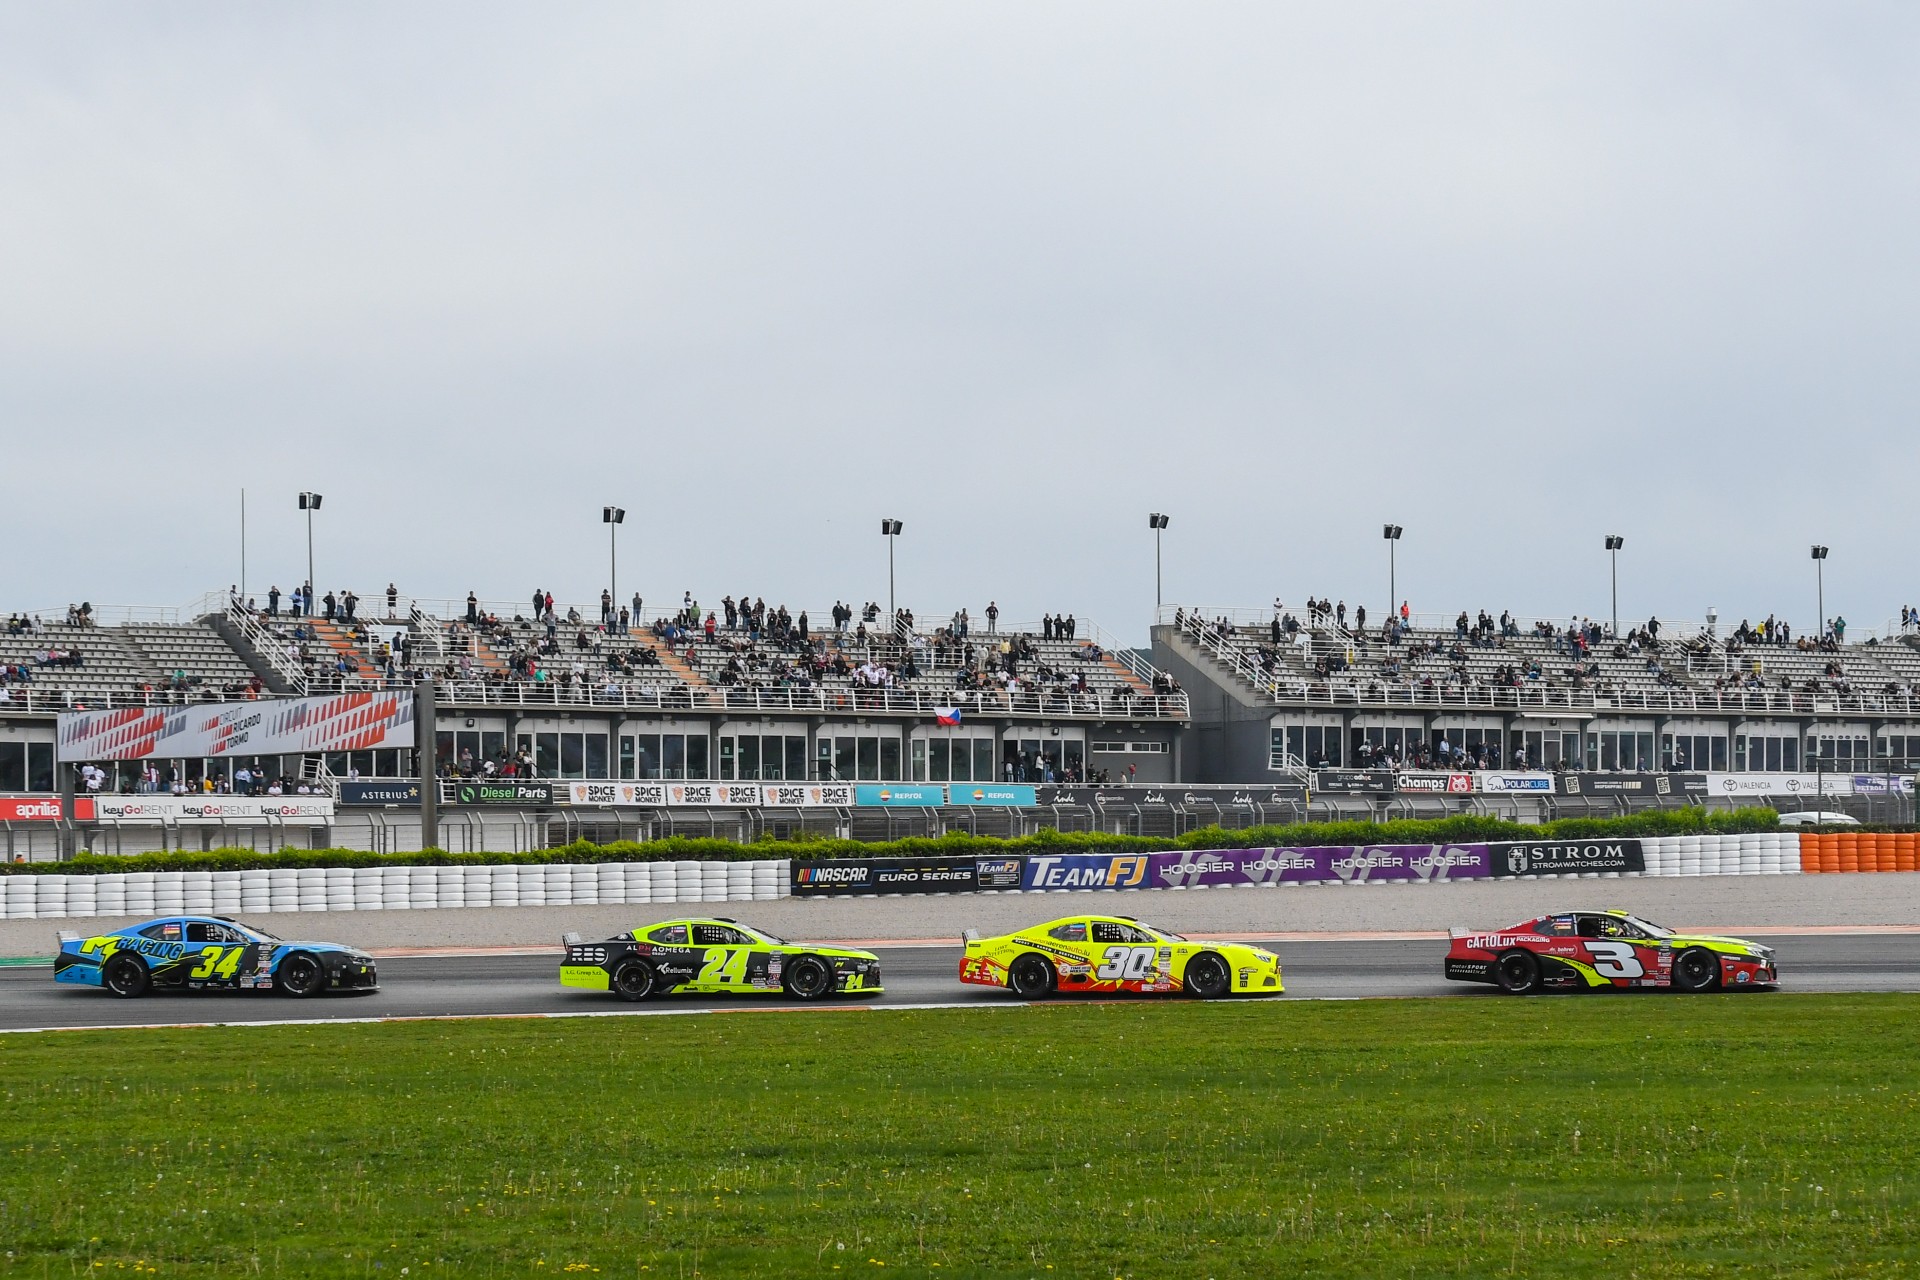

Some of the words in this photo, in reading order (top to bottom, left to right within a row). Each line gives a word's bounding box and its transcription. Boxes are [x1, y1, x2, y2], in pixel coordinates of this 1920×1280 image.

[219, 706, 243, 725] CIRCUIT
[232, 713, 261, 733] RICARDO
[226, 731, 249, 749] TORMO
[1398, 775, 1444, 791] Champs
[1506, 780, 1548, 789] POLARCUBE
[361, 791, 408, 800] ASTERIUS
[480, 787, 515, 798] Diesel
[517, 787, 547, 798] Parts
[588, 786, 616, 796] SPICE
[635, 787, 661, 796] SPICE
[684, 787, 711, 796] SPICE
[729, 787, 756, 796] SPICE
[778, 788, 804, 798] SPICE
[822, 788, 848, 798] SPICE
[16, 803, 60, 817] aprilia
[1531, 845, 1625, 860] STROM
[1241, 859, 1315, 871] HOOSIER
[1331, 857, 1403, 869] HOOSIER
[1410, 856, 1481, 867] HOOSIER
[1532, 860, 1625, 869] STROMWATCHES.COM
[815, 868, 868, 882] NASCAR
[879, 873, 918, 882] EURO
[922, 872, 971, 881] SERIES
[1159, 862, 1235, 876] HOOSIER
[115, 937, 183, 960] RACING
[571, 947, 606, 962] RES
[190, 945, 244, 980] 34
[698, 947, 751, 984] 24
[1096, 946, 1156, 981] 30
[1584, 941, 1644, 979] 3
[845, 974, 863, 989] 24
